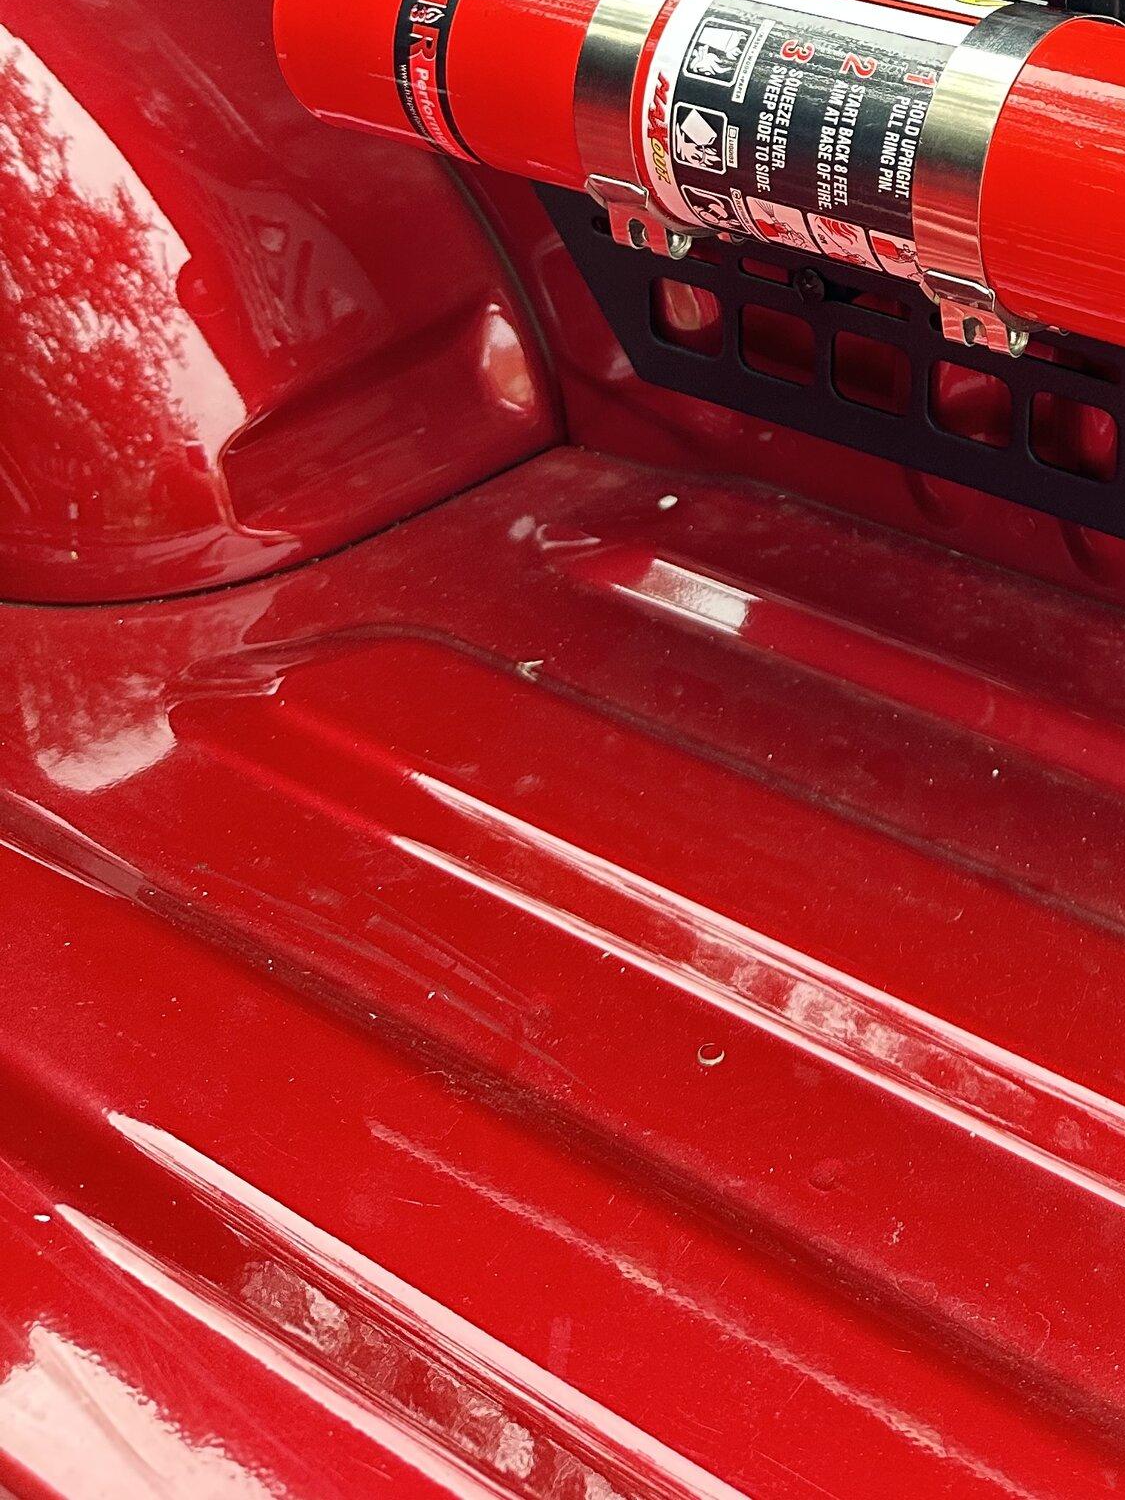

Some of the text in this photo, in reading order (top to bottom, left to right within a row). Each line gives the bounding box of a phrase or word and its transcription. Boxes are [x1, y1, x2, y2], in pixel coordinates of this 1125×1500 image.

[780, 40, 815, 63] 3
[840, 53, 877, 78] 2
[903, 71, 937, 89] 1
[755, 65, 787, 193] SWEEP SIDE TO SIDE.
[772, 68, 803, 171] SQUEEZE LEVER.
[817, 79, 847, 211] AIM AT BASE OF FIRE.
[833, 84, 865, 206] START BACK 8 FEET.
[878, 95, 908, 194] PULL RING PIN.
[895, 99, 925, 198] HOLD UPRIGHT.
